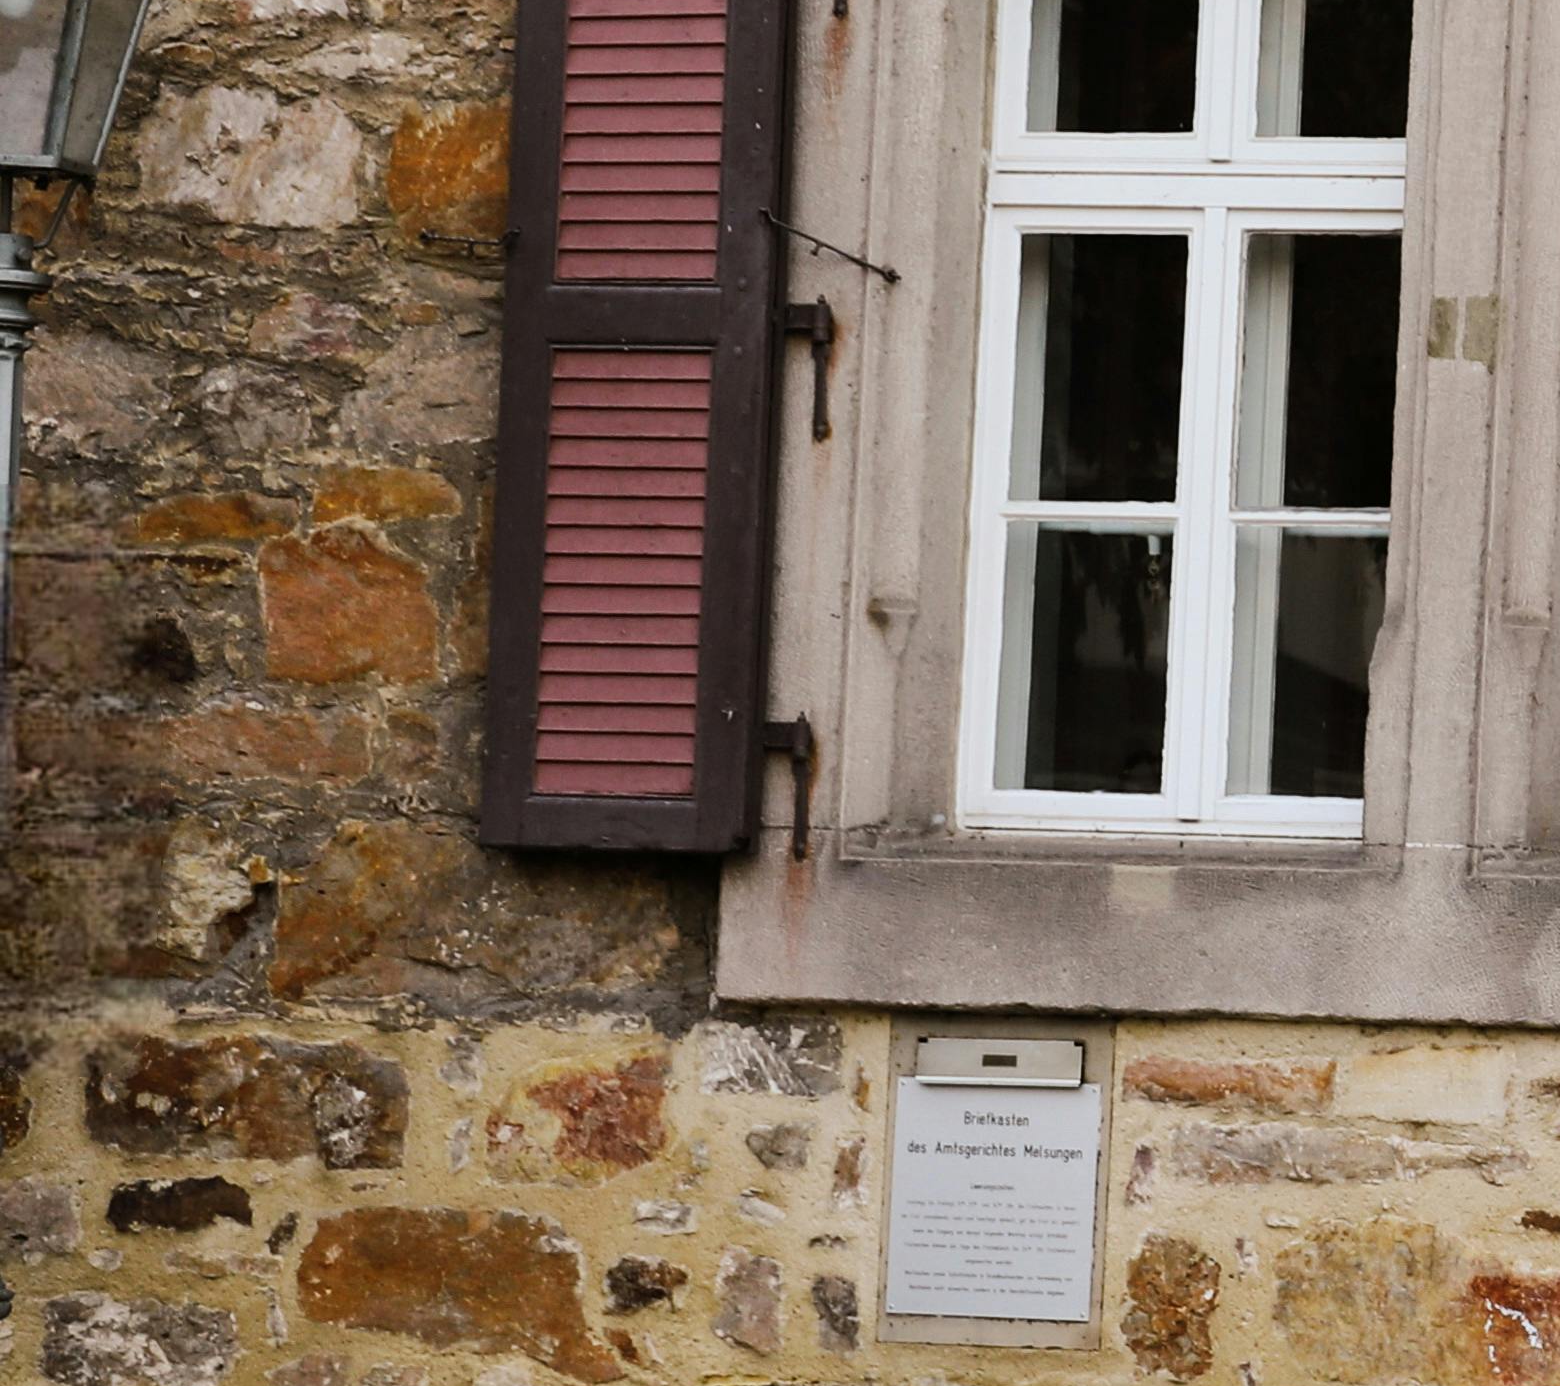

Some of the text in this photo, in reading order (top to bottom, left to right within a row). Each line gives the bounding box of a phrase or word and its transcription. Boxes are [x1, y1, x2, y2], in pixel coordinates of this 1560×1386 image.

[963, 1111, 1030, 1127] Briefkasten
[907, 1141, 1083, 1163] des Amtsgerichtes Melsungen
